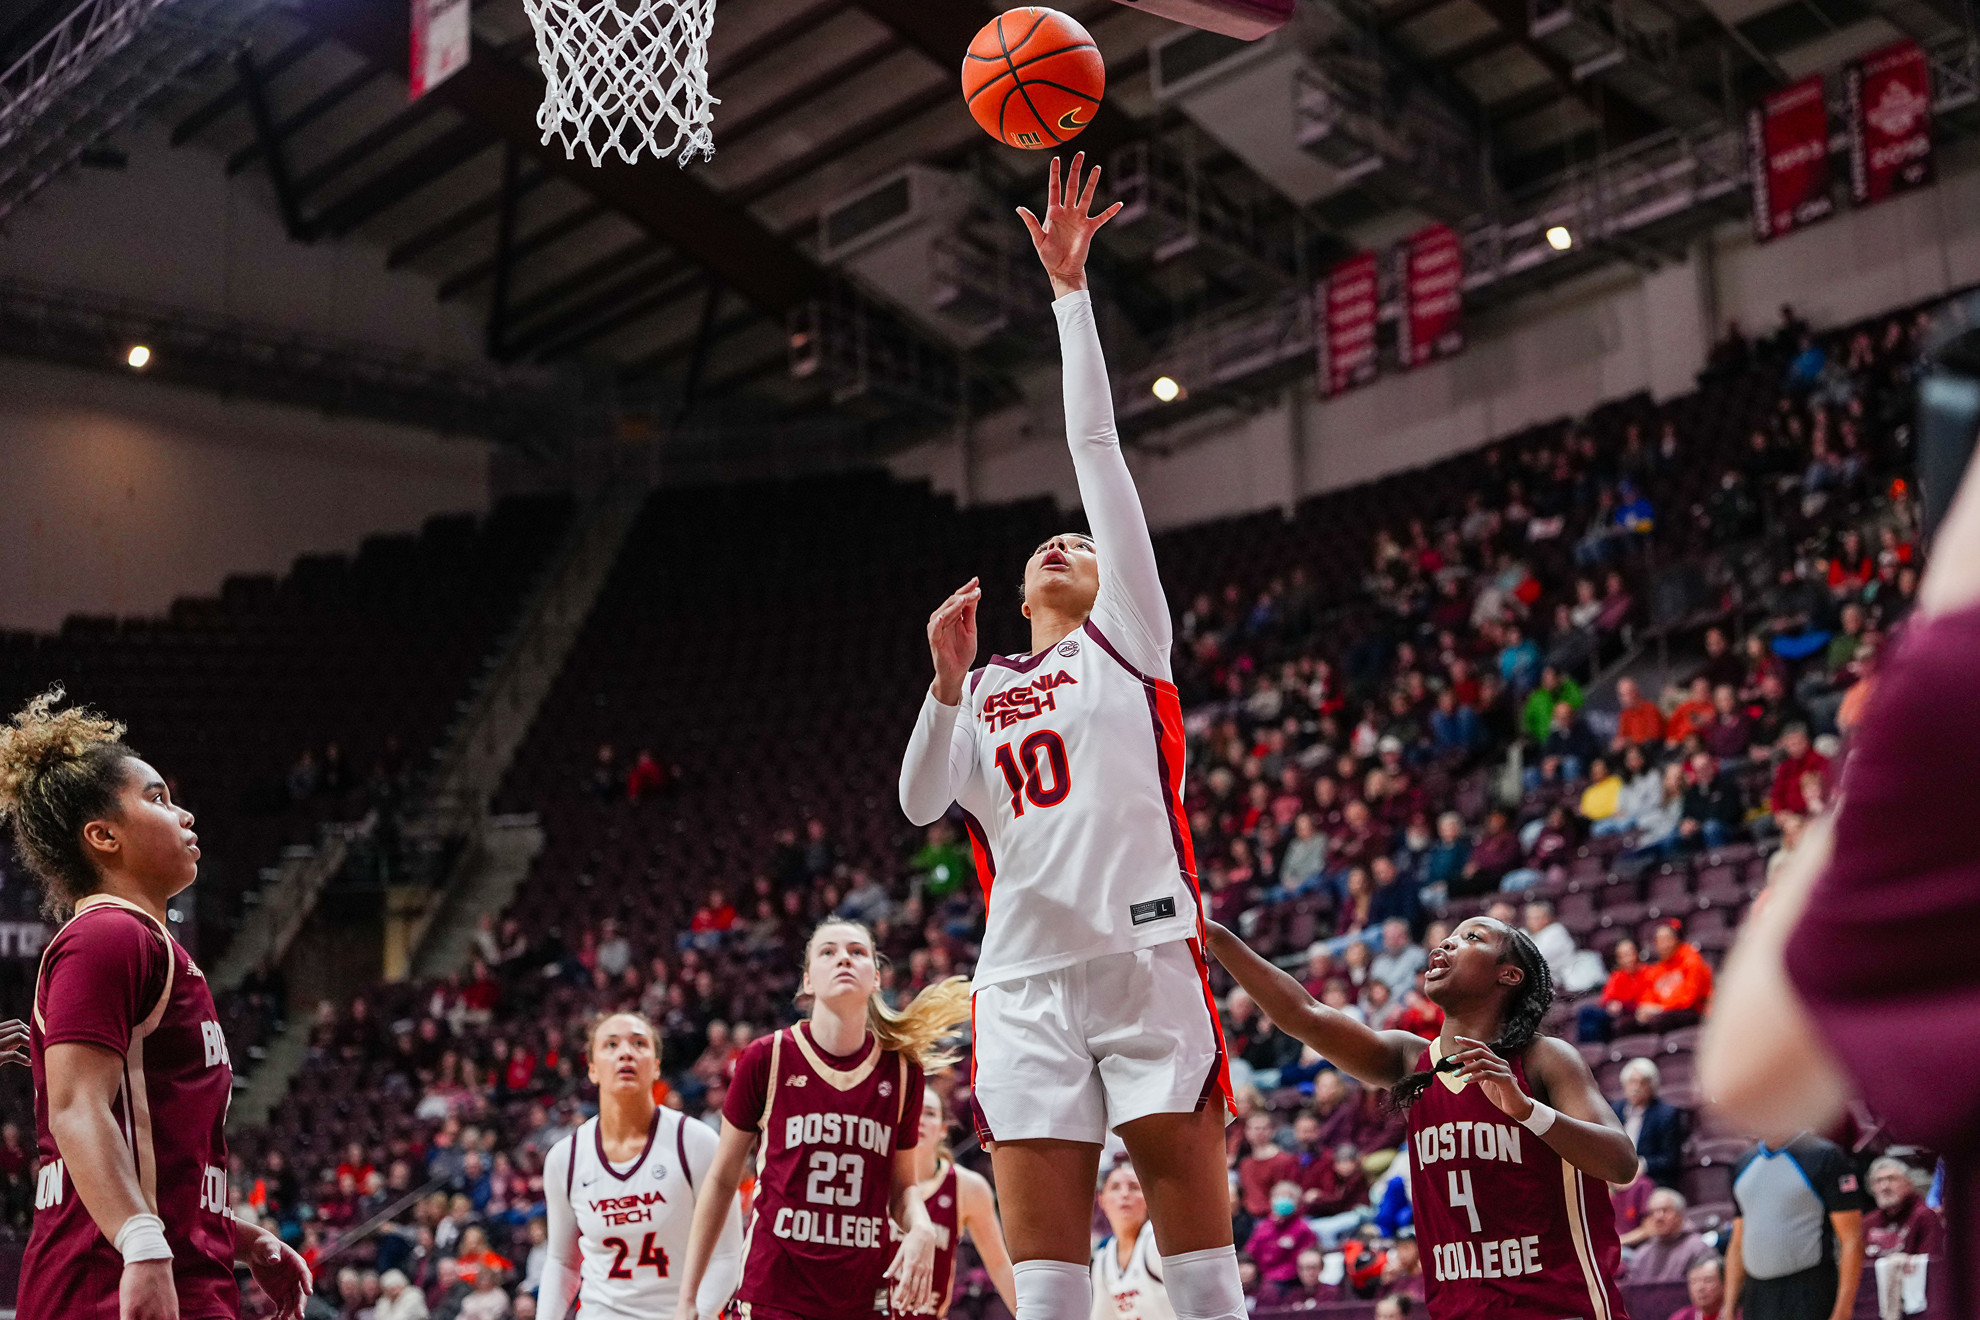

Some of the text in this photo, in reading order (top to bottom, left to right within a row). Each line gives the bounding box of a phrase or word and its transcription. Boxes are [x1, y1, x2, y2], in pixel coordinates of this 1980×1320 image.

[984, 691, 1056, 734] TECH
[994, 729, 1071, 819] 10
[1161, 903, 1168, 912] L
[785, 1112, 892, 1157] BOSTON
[806, 1150, 865, 1207] 23
[1447, 1169, 1482, 1233] 4
[588, 1190, 667, 1213] VIRGINIA
[602, 1208, 652, 1227] TECH
[772, 1207, 883, 1249] COLLEGE
[602, 1231, 670, 1279] 24
[1432, 1235, 1543, 1282] COLLEGE
